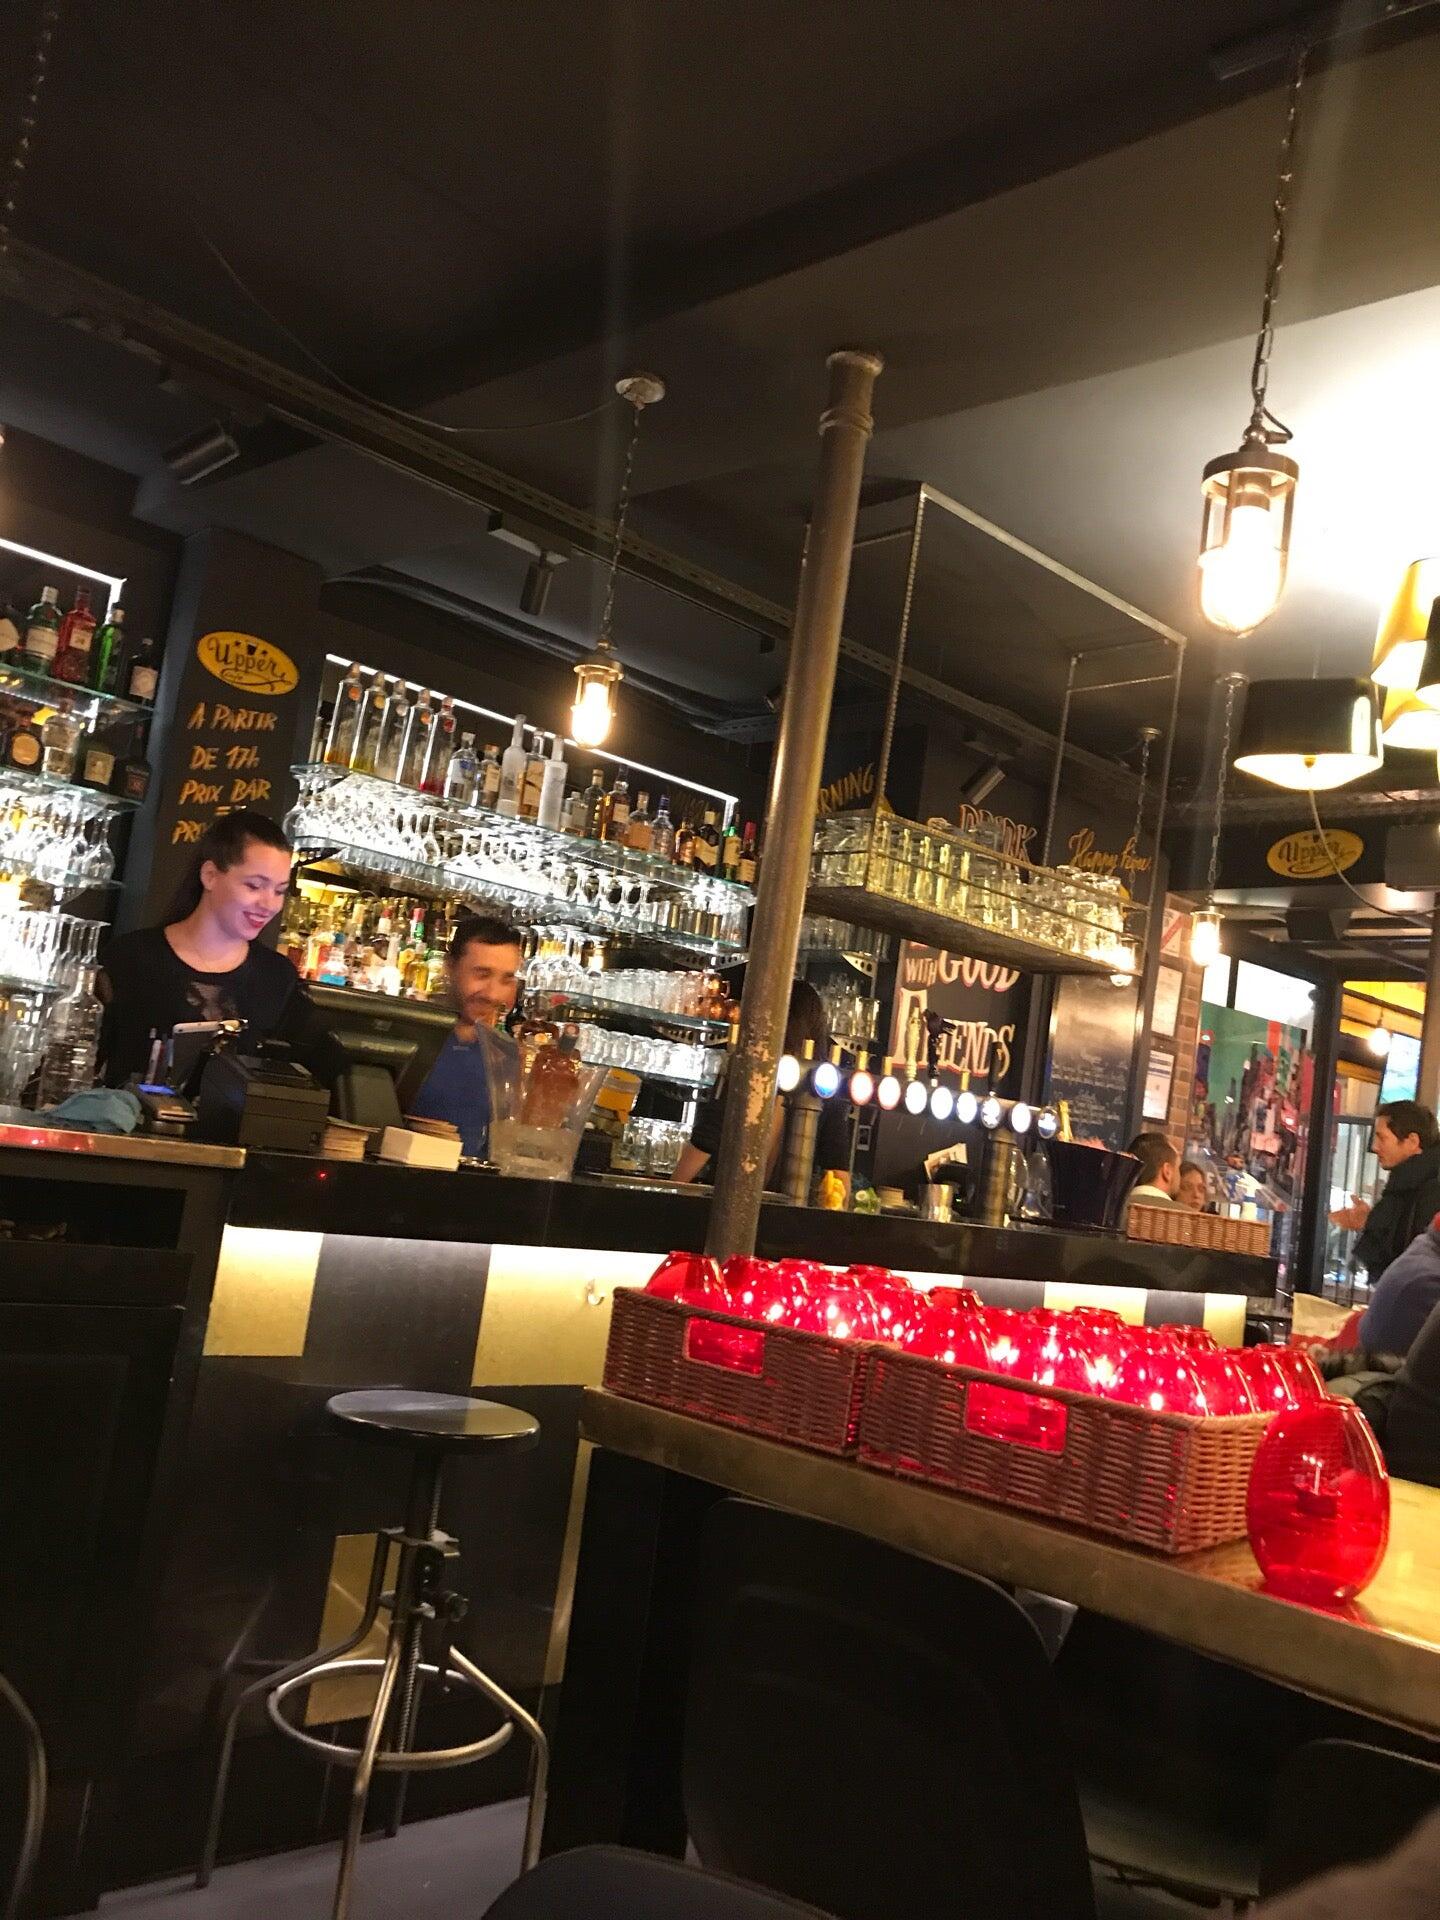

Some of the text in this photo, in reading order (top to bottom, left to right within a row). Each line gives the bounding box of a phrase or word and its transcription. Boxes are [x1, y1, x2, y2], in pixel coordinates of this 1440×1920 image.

[207, 637, 285, 678] Upper
[188, 703, 278, 732] A PARTIR
[191, 746, 220, 769] DE
[179, 778, 272, 805] PRIX BAR
[816, 762, 875, 815] RNING
[960, 803, 1038, 866] DNK
[905, 957, 937, 988] WITH
